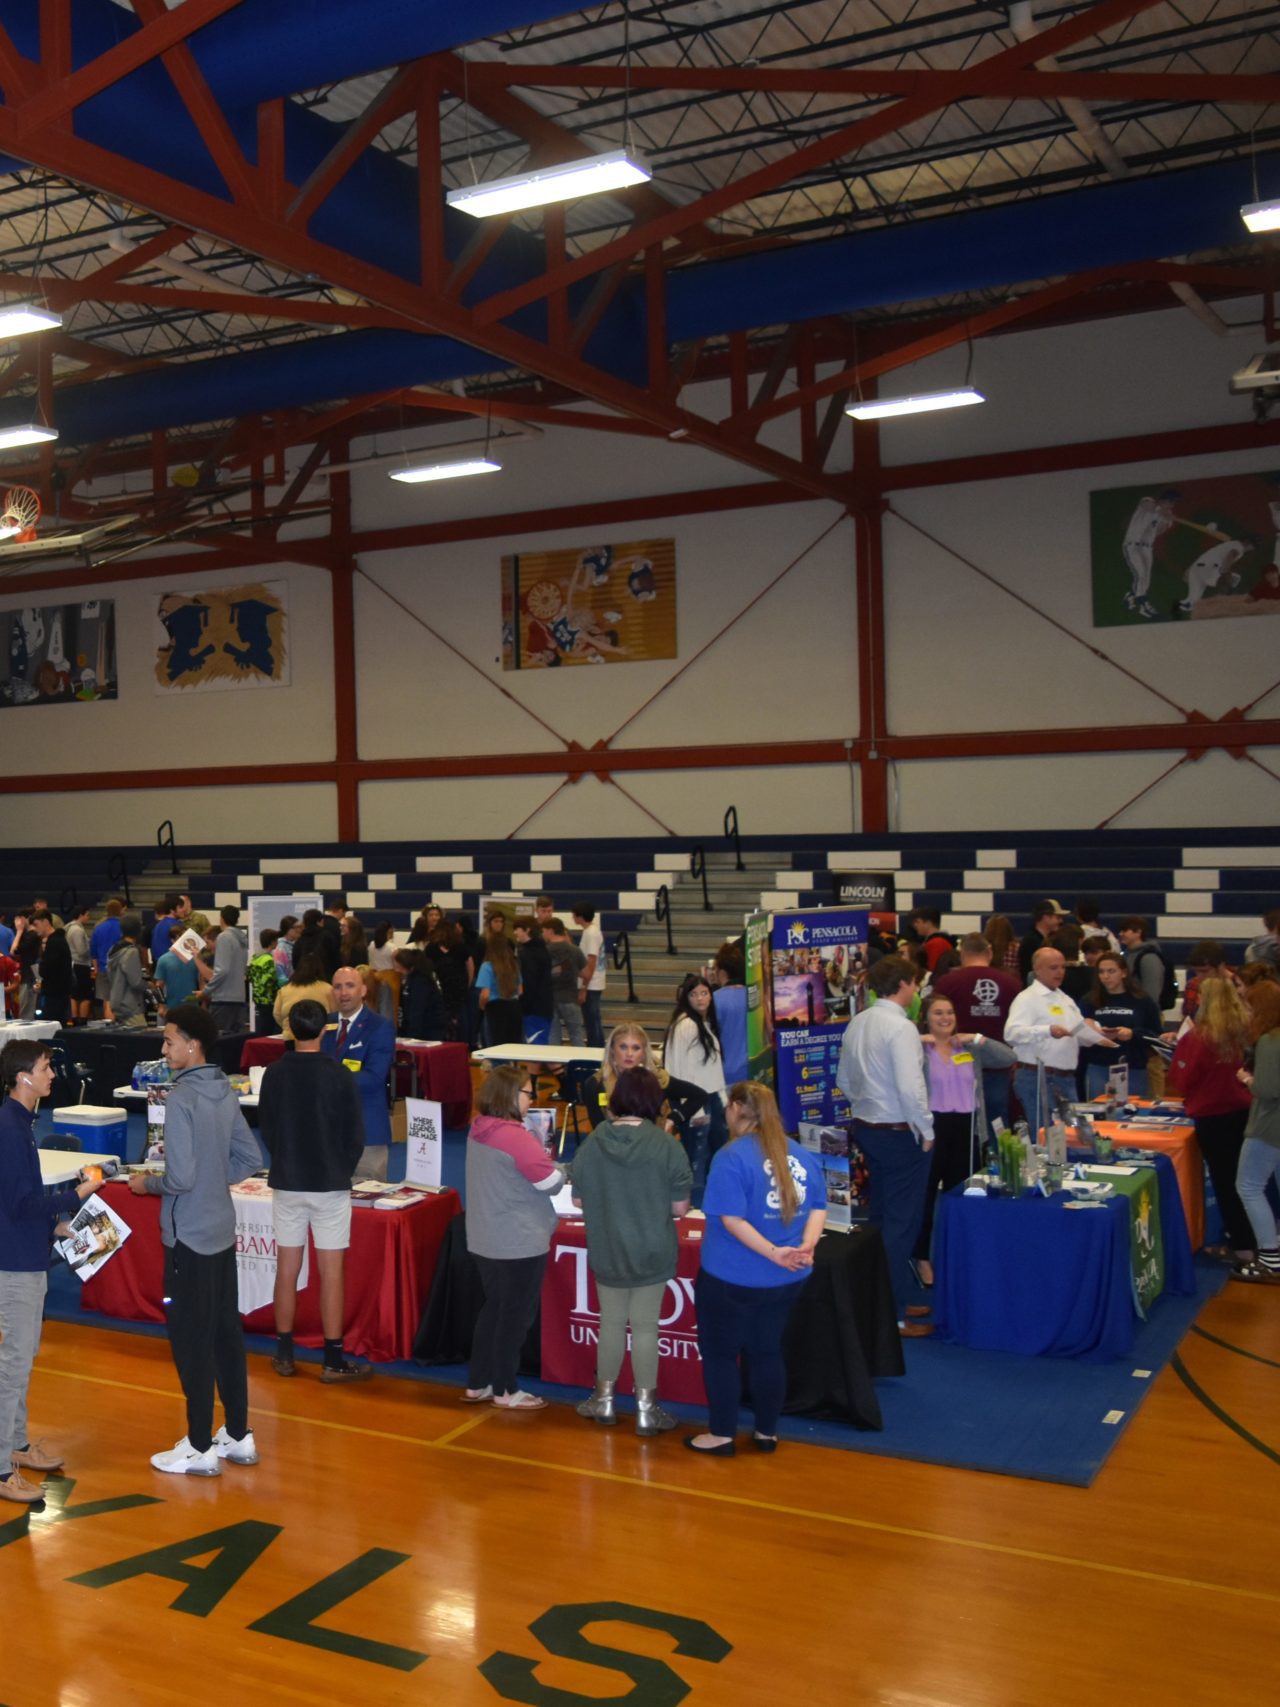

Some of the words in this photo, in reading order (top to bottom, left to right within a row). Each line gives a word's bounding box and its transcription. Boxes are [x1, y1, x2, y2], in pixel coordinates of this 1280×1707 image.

[840, 886, 885, 898] LINCOLN
[812, 926, 858, 938] PENSACOLA
[780, 1031, 795, 1039] YOU
[796, 1029, 809, 1037] CAN
[805, 1035, 827, 1044] DEGREE
[413, 1116, 432, 1126] WHERE
[410, 1122, 435, 1133] LEGENDS
[409, 1130, 419, 1138] ARE
[421, 1133, 437, 1141] MADE
